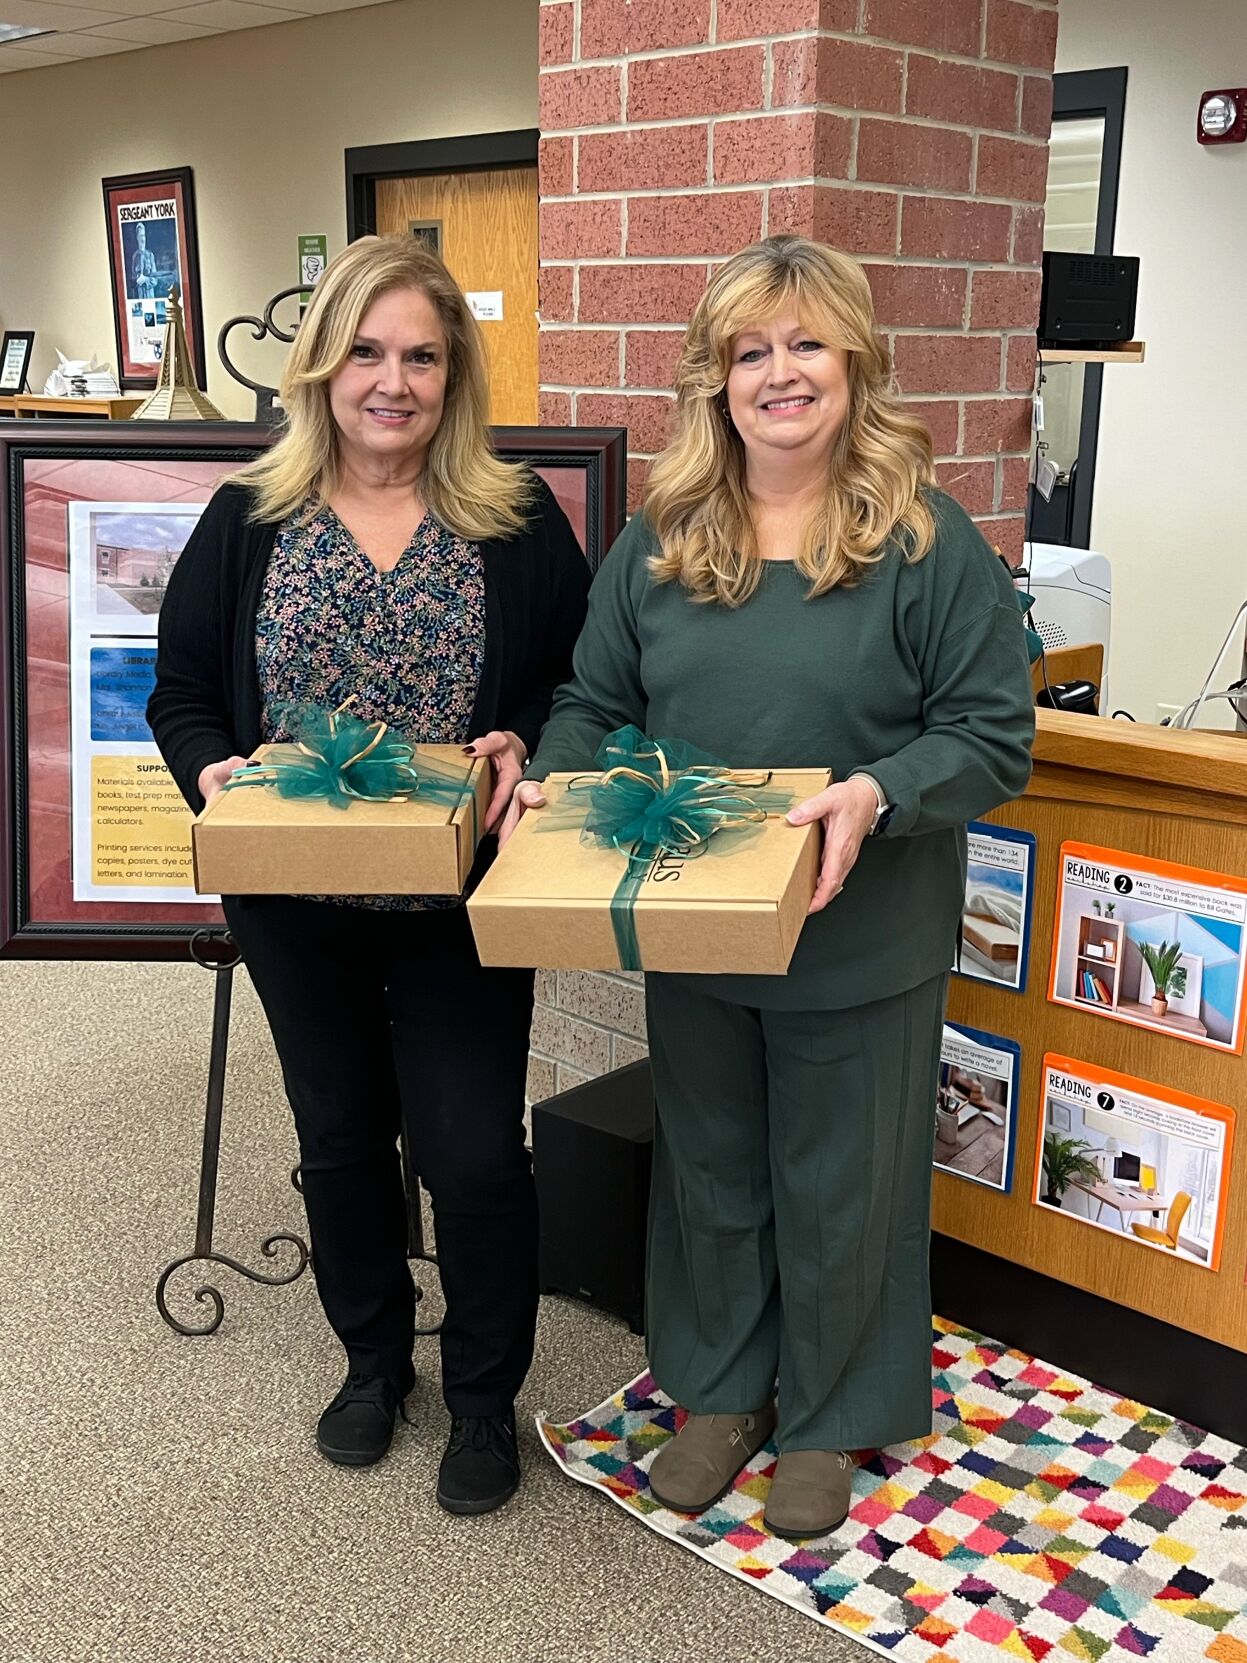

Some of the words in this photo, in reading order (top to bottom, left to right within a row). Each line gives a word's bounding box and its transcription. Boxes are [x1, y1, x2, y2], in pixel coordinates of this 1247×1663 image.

[120, 205, 153, 221] SERGEANT
[154, 202, 175, 217] YORK
[136, 764, 169, 773] SUPPO
[97, 778, 134, 786] Materials
[136, 778, 174, 786] available
[97, 791, 125, 799] books,
[143, 792, 162, 801] prep
[97, 805, 149, 814] newspapers,
[97, 818, 144, 826] calculators.
[97, 844, 128, 853] Printing
[129, 844, 163, 852] services
[162, 857, 177, 866] dye
[126, 870, 142, 878] and
[1067, 861, 1110, 884] READING
[1165, 888, 1180, 896] most
[1050, 1074, 1091, 1098] READING
